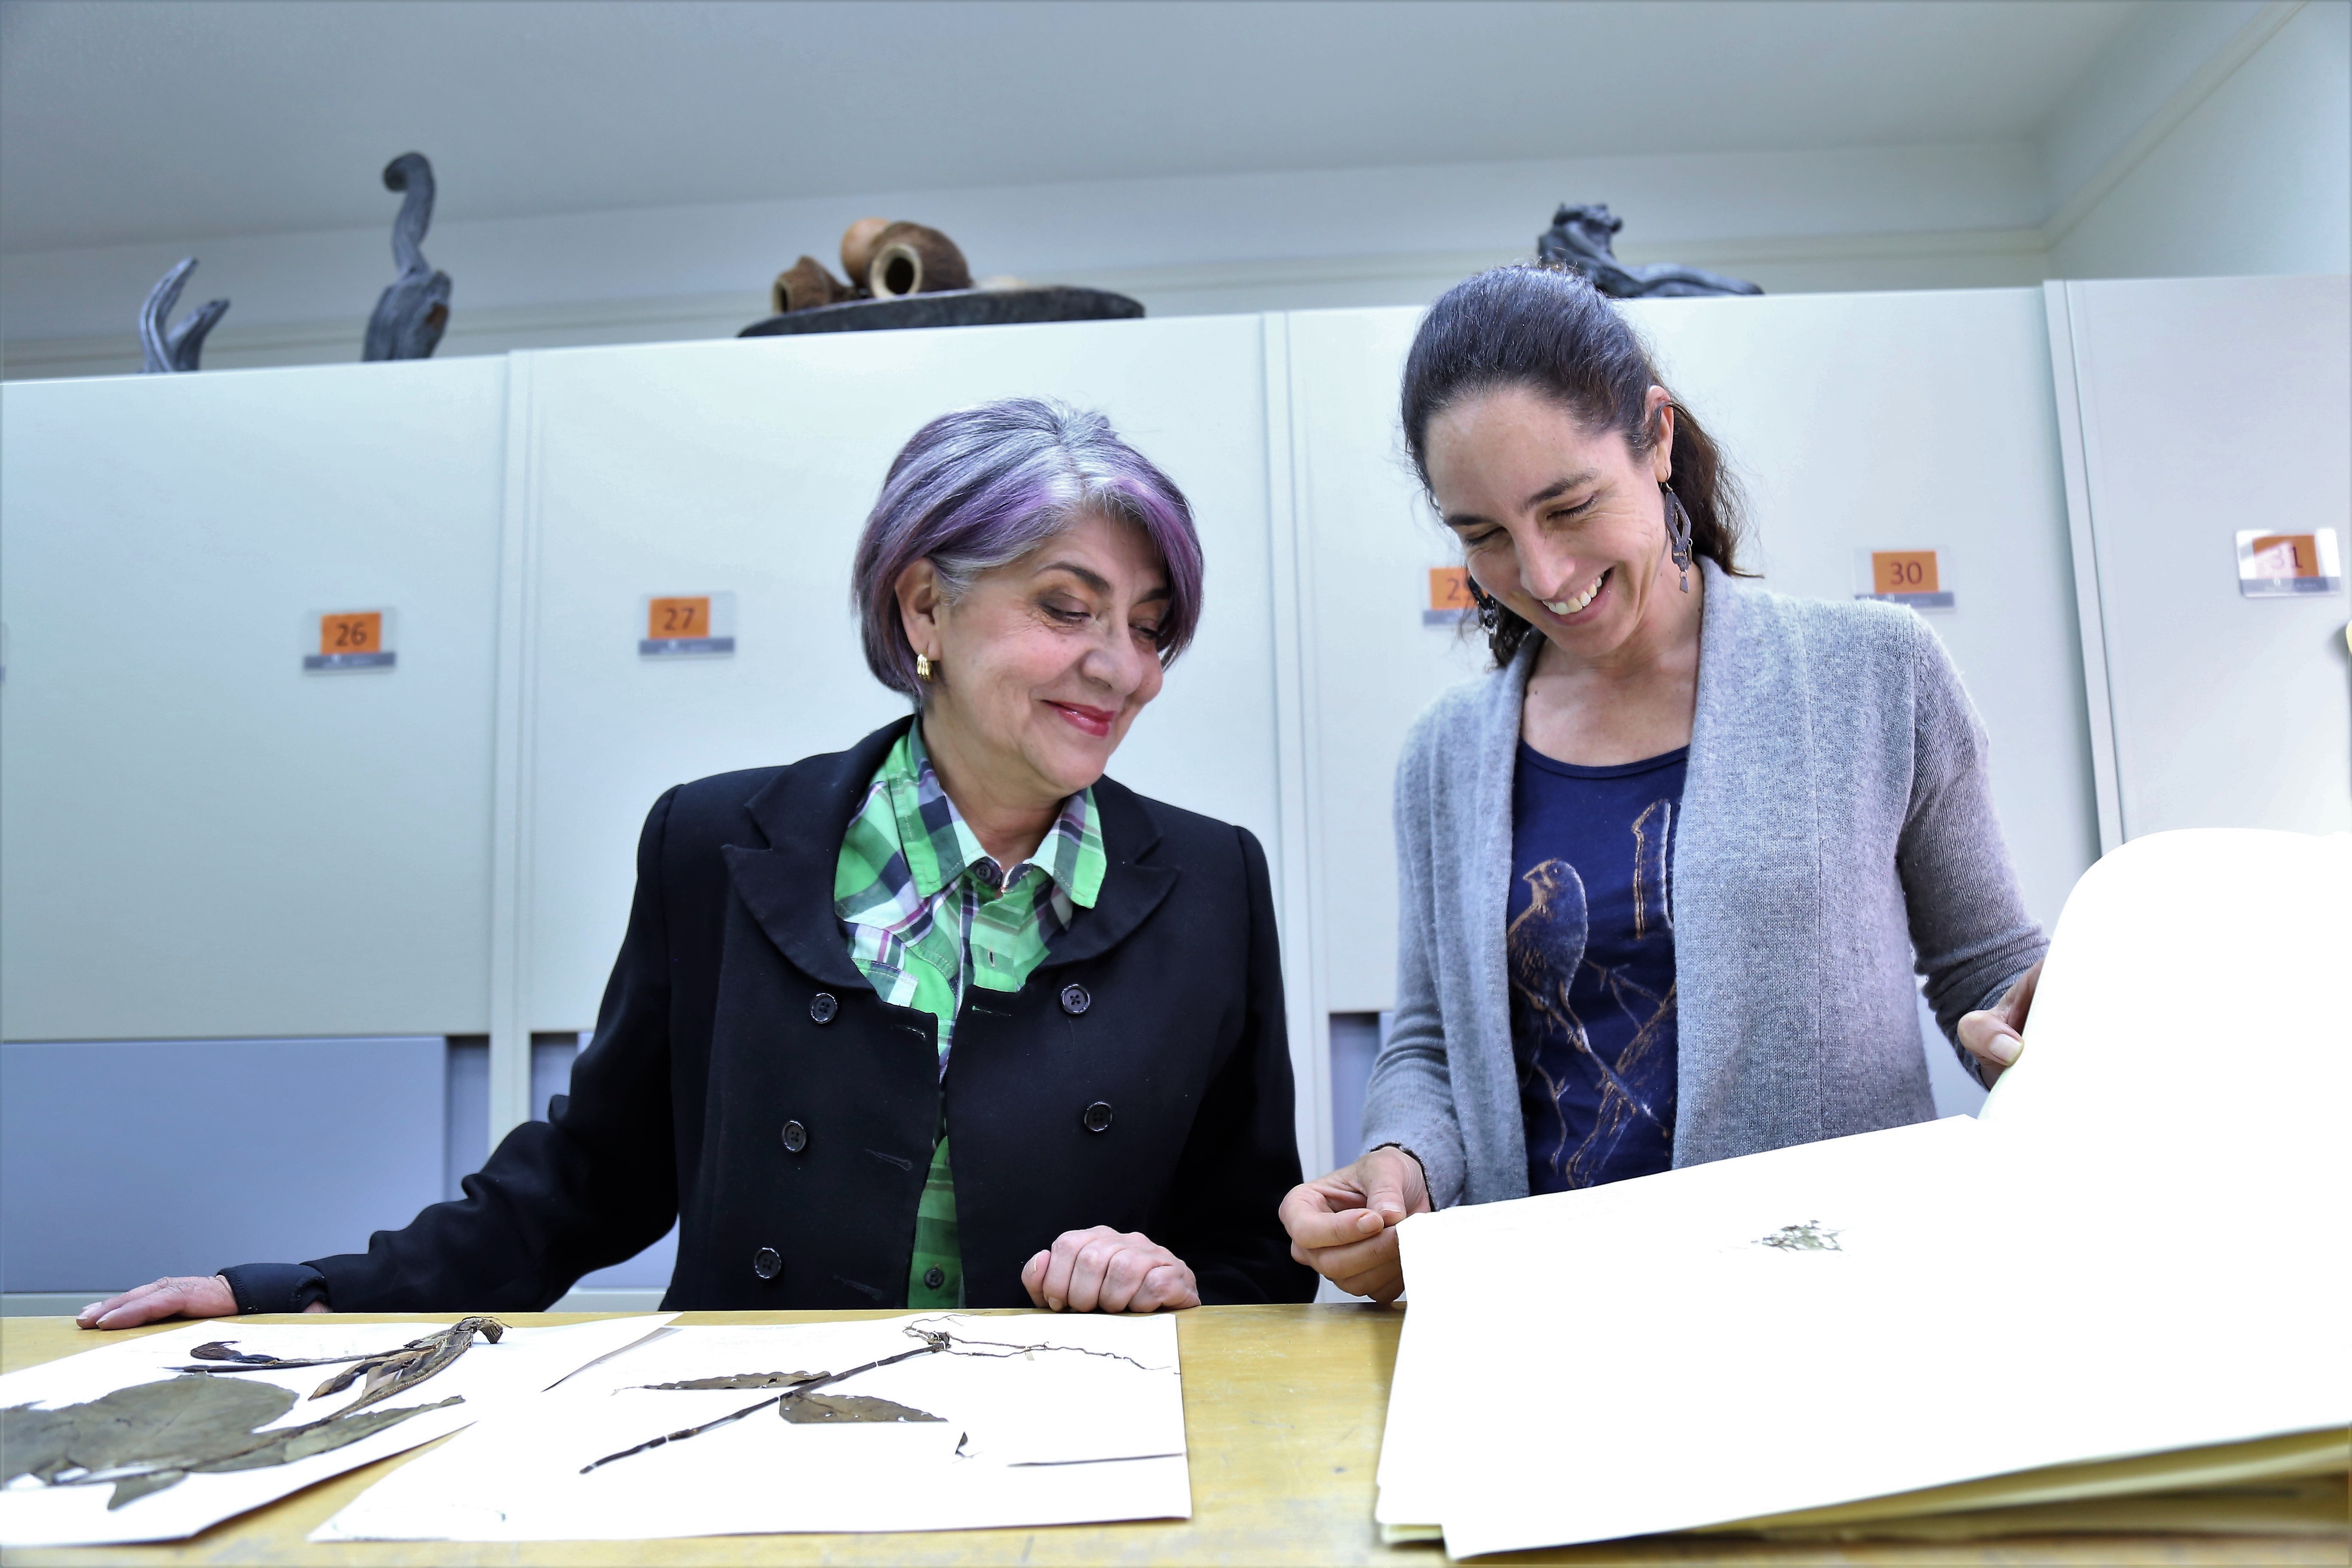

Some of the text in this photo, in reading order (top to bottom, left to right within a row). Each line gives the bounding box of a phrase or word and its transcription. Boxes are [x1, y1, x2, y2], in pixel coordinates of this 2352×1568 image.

[2270, 546, 2303, 570] 31
[1890, 561, 1923, 585] 30
[663, 607, 694, 631] 27
[335, 622, 368, 646] 26
